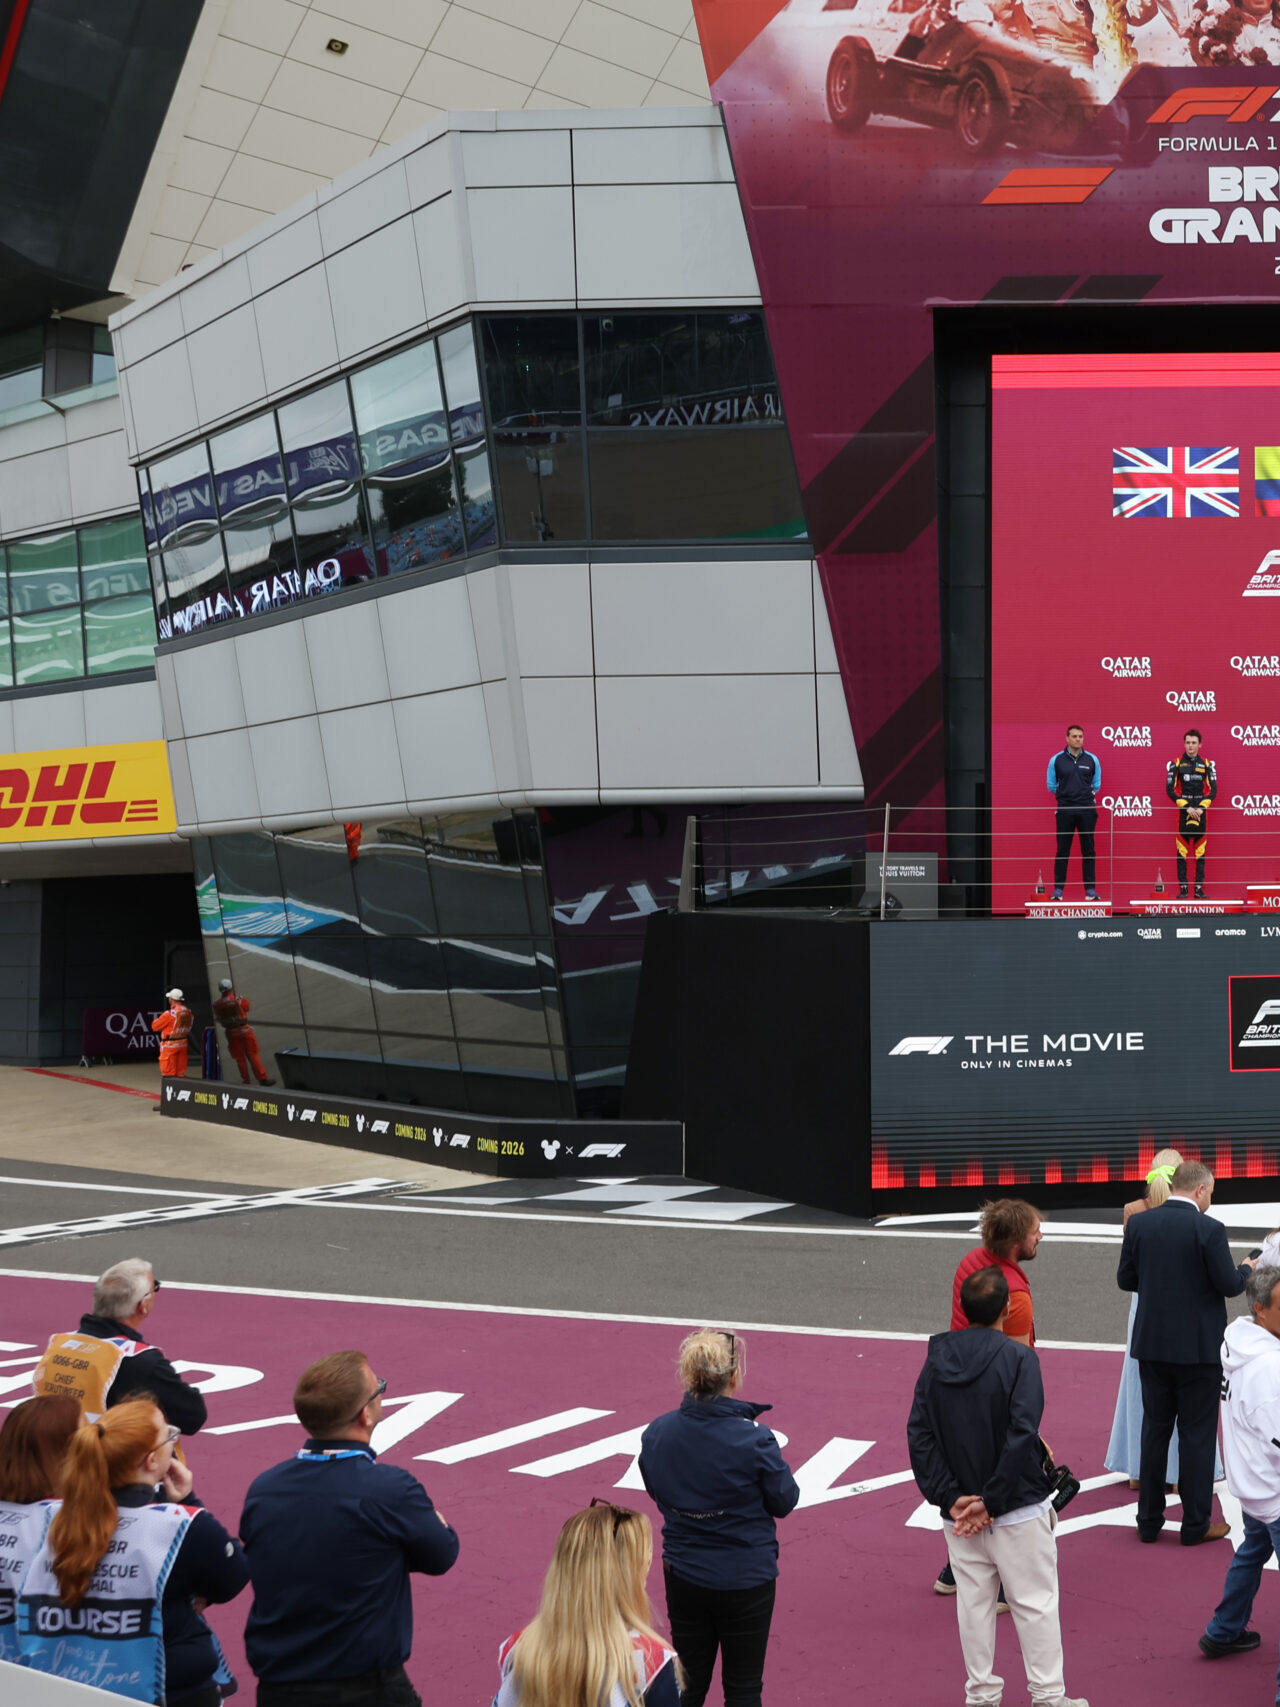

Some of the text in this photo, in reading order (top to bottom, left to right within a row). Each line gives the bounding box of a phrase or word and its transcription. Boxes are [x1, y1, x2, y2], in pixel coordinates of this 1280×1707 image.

[1158, 136, 1259, 152] FORMULA
[1267, 136, 1277, 151] 1
[1101, 657, 1151, 671] QATAR
[1230, 656, 1280, 670] QATAR
[1166, 691, 1215, 706] QATAR
[1178, 704, 1216, 712] AIRWAYS
[1101, 726, 1151, 741] QATAR
[1230, 725, 1280, 740] QATAR
[1113, 739, 1152, 747] AIRWAYS
[1242, 738, 1280, 746] AIRWAYS
[1102, 796, 1152, 811] QATAR
[1231, 795, 1280, 810] QATAR
[1113, 809, 1152, 817] AIRWAYS
[1029, 907, 1106, 917] MOËT & CHANDON
[1170, 905, 1178, 914] &
[1179, 905, 1225, 914] CHANDON
[1088, 931, 1123, 939] crypto.com
[1137, 928, 1161, 937] QATAR
[105, 1012, 162, 1038] QAT
[964, 1034, 1029, 1054] THE
[1043, 1032, 1145, 1053] MOVIE
[961, 1059, 1073, 1069] ONLY IN CINEMAS
[194, 1092, 207, 1105] COMING
[208, 1094, 217, 1106] 2026
[253, 1100, 267, 1114] COMING
[268, 1102, 278, 1116] 2026
[321, 1112, 337, 1126] COMING
[338, 1113, 349, 1128] 2026
[395, 1123, 413, 1139] COMING
[414, 1125, 426, 1141] 2026
[477, 1137, 498, 1154] COMING
[501, 1140, 525, 1155] 2026
[54, 1373, 75, 1384] CHIEF
[92, 1563, 139, 1578] ESCUE
[36, 1606, 142, 1634] COURSE
